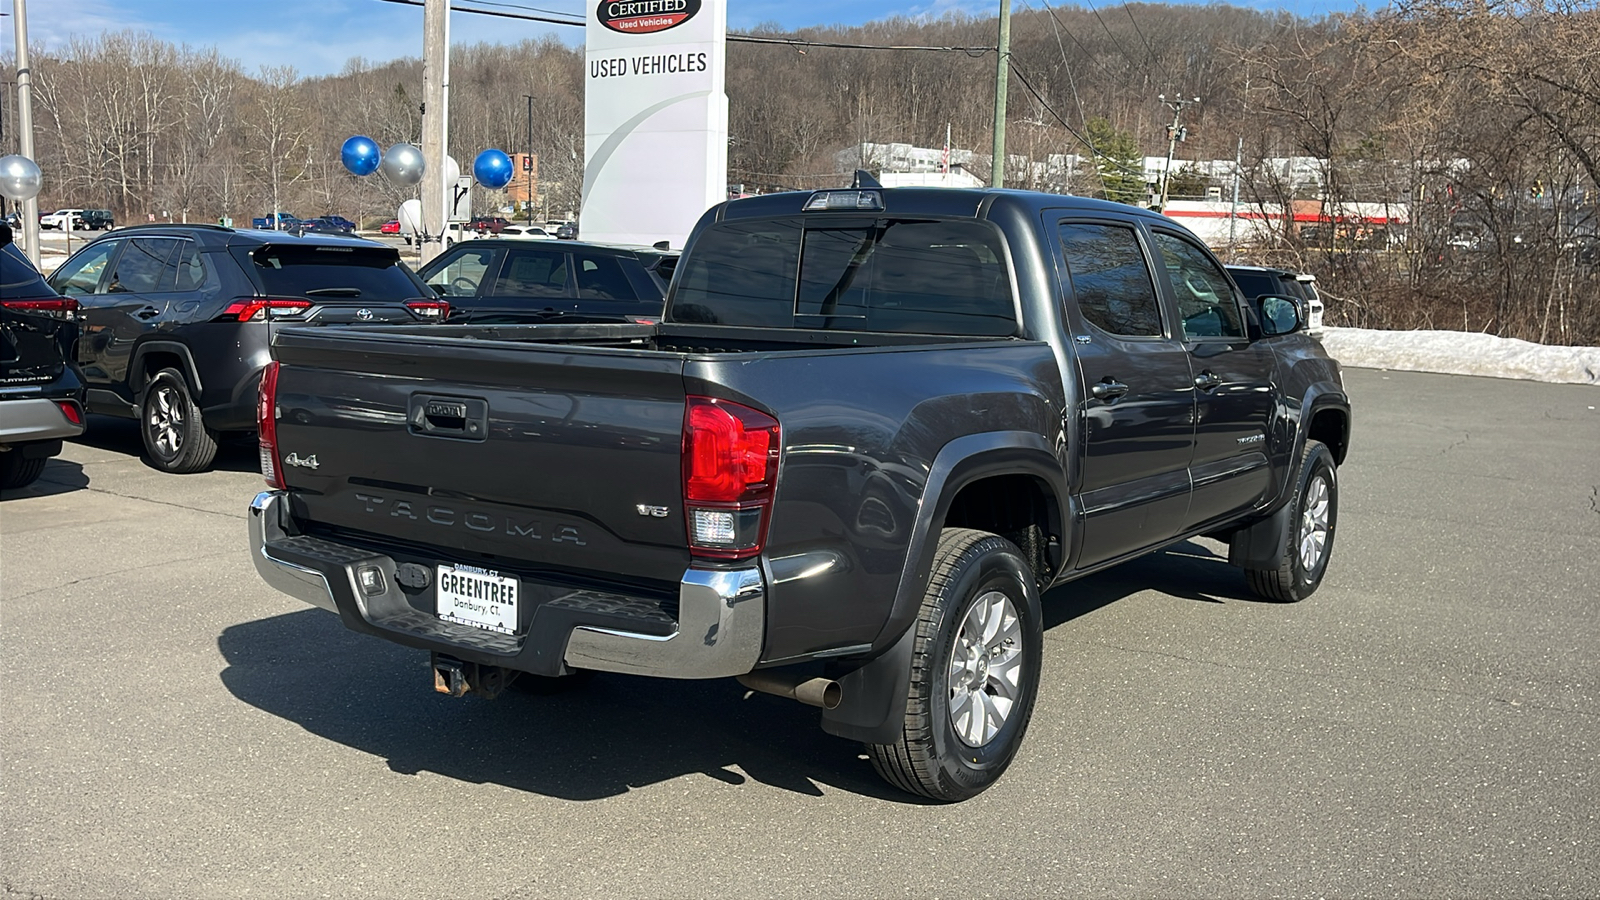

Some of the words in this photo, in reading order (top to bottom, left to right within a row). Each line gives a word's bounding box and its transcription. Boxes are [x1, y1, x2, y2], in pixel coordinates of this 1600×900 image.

[608, 0, 687, 17] CERTIFIED
[619, 20, 638, 29] Used
[640, 17, 673, 28] Vehicles
[591, 58, 627, 79] USED
[632, 52, 707, 75] VEHICLES
[429, 404, 461, 417] TOYOTA
[355, 493, 587, 546] TACOMA
[636, 504, 669, 517] V6
[441, 573, 514, 606] GREENTREE
[454, 597, 488, 616] Danbury,
[489, 605, 501, 616] CT.
